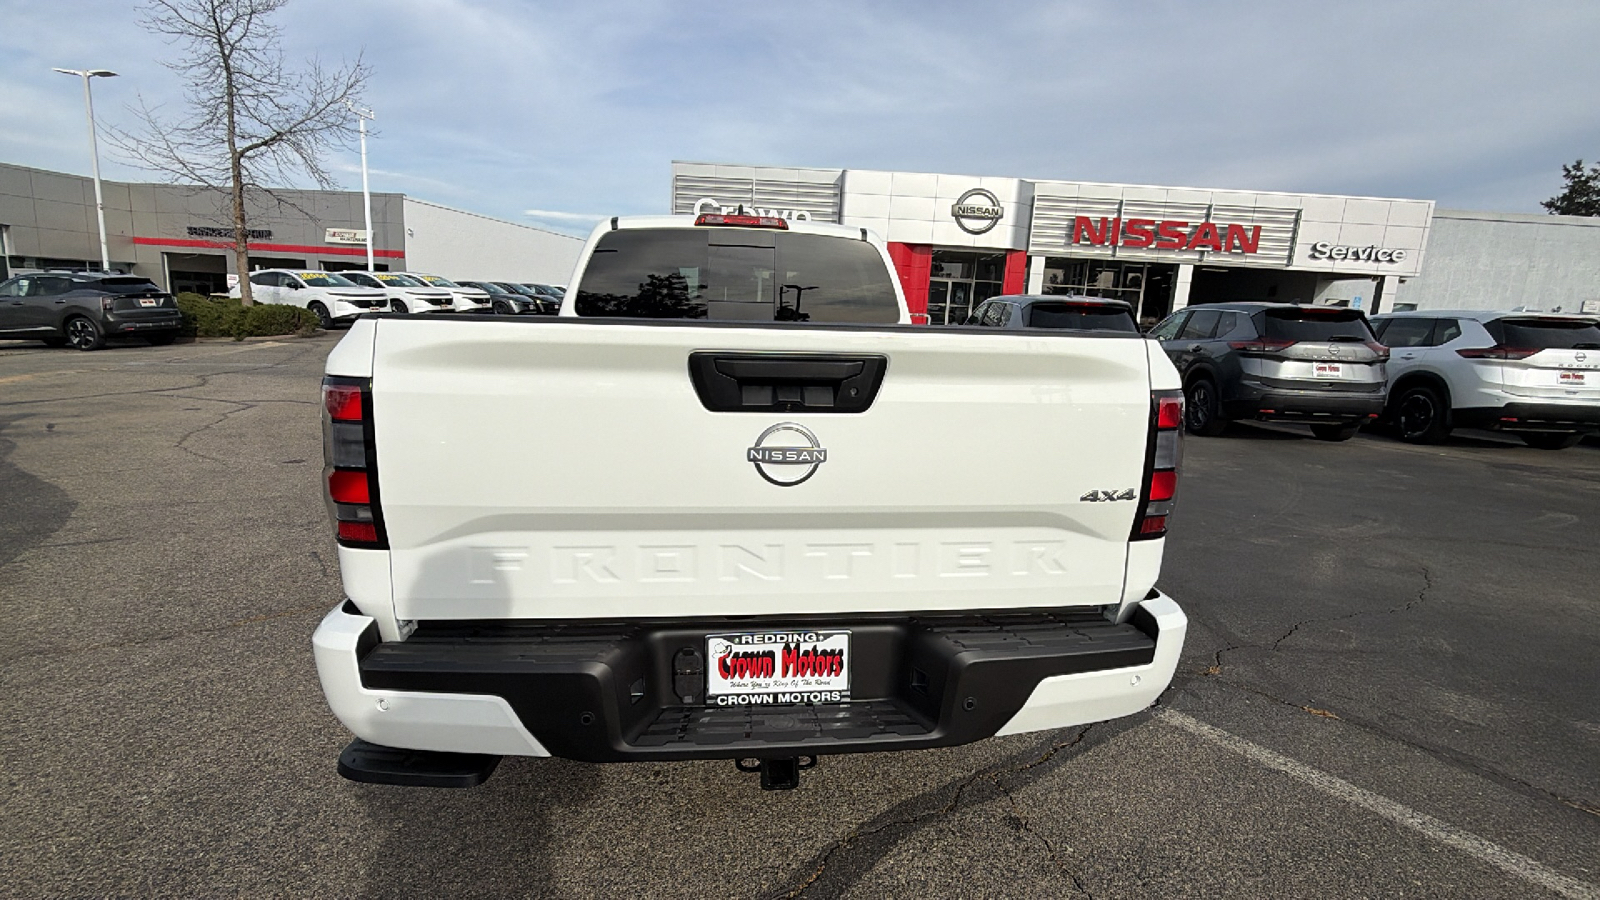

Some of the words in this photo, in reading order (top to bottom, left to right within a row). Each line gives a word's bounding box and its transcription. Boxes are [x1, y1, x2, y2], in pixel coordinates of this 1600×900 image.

[956, 206, 999, 216] NISSAN
[1072, 215, 1262, 254] NISSAN
[1311, 241, 1407, 263] Service
[750, 449, 825, 461] NISSAN
[469, 540, 1068, 584] FRONTIER
[741, 633, 817, 644] REDDING
[718, 647, 775, 680] Crown
[781, 644, 843, 678] Motors
[772, 680, 788, 688] King
[717, 694, 773, 706] CROWN
[777, 691, 841, 704] MOTORS
